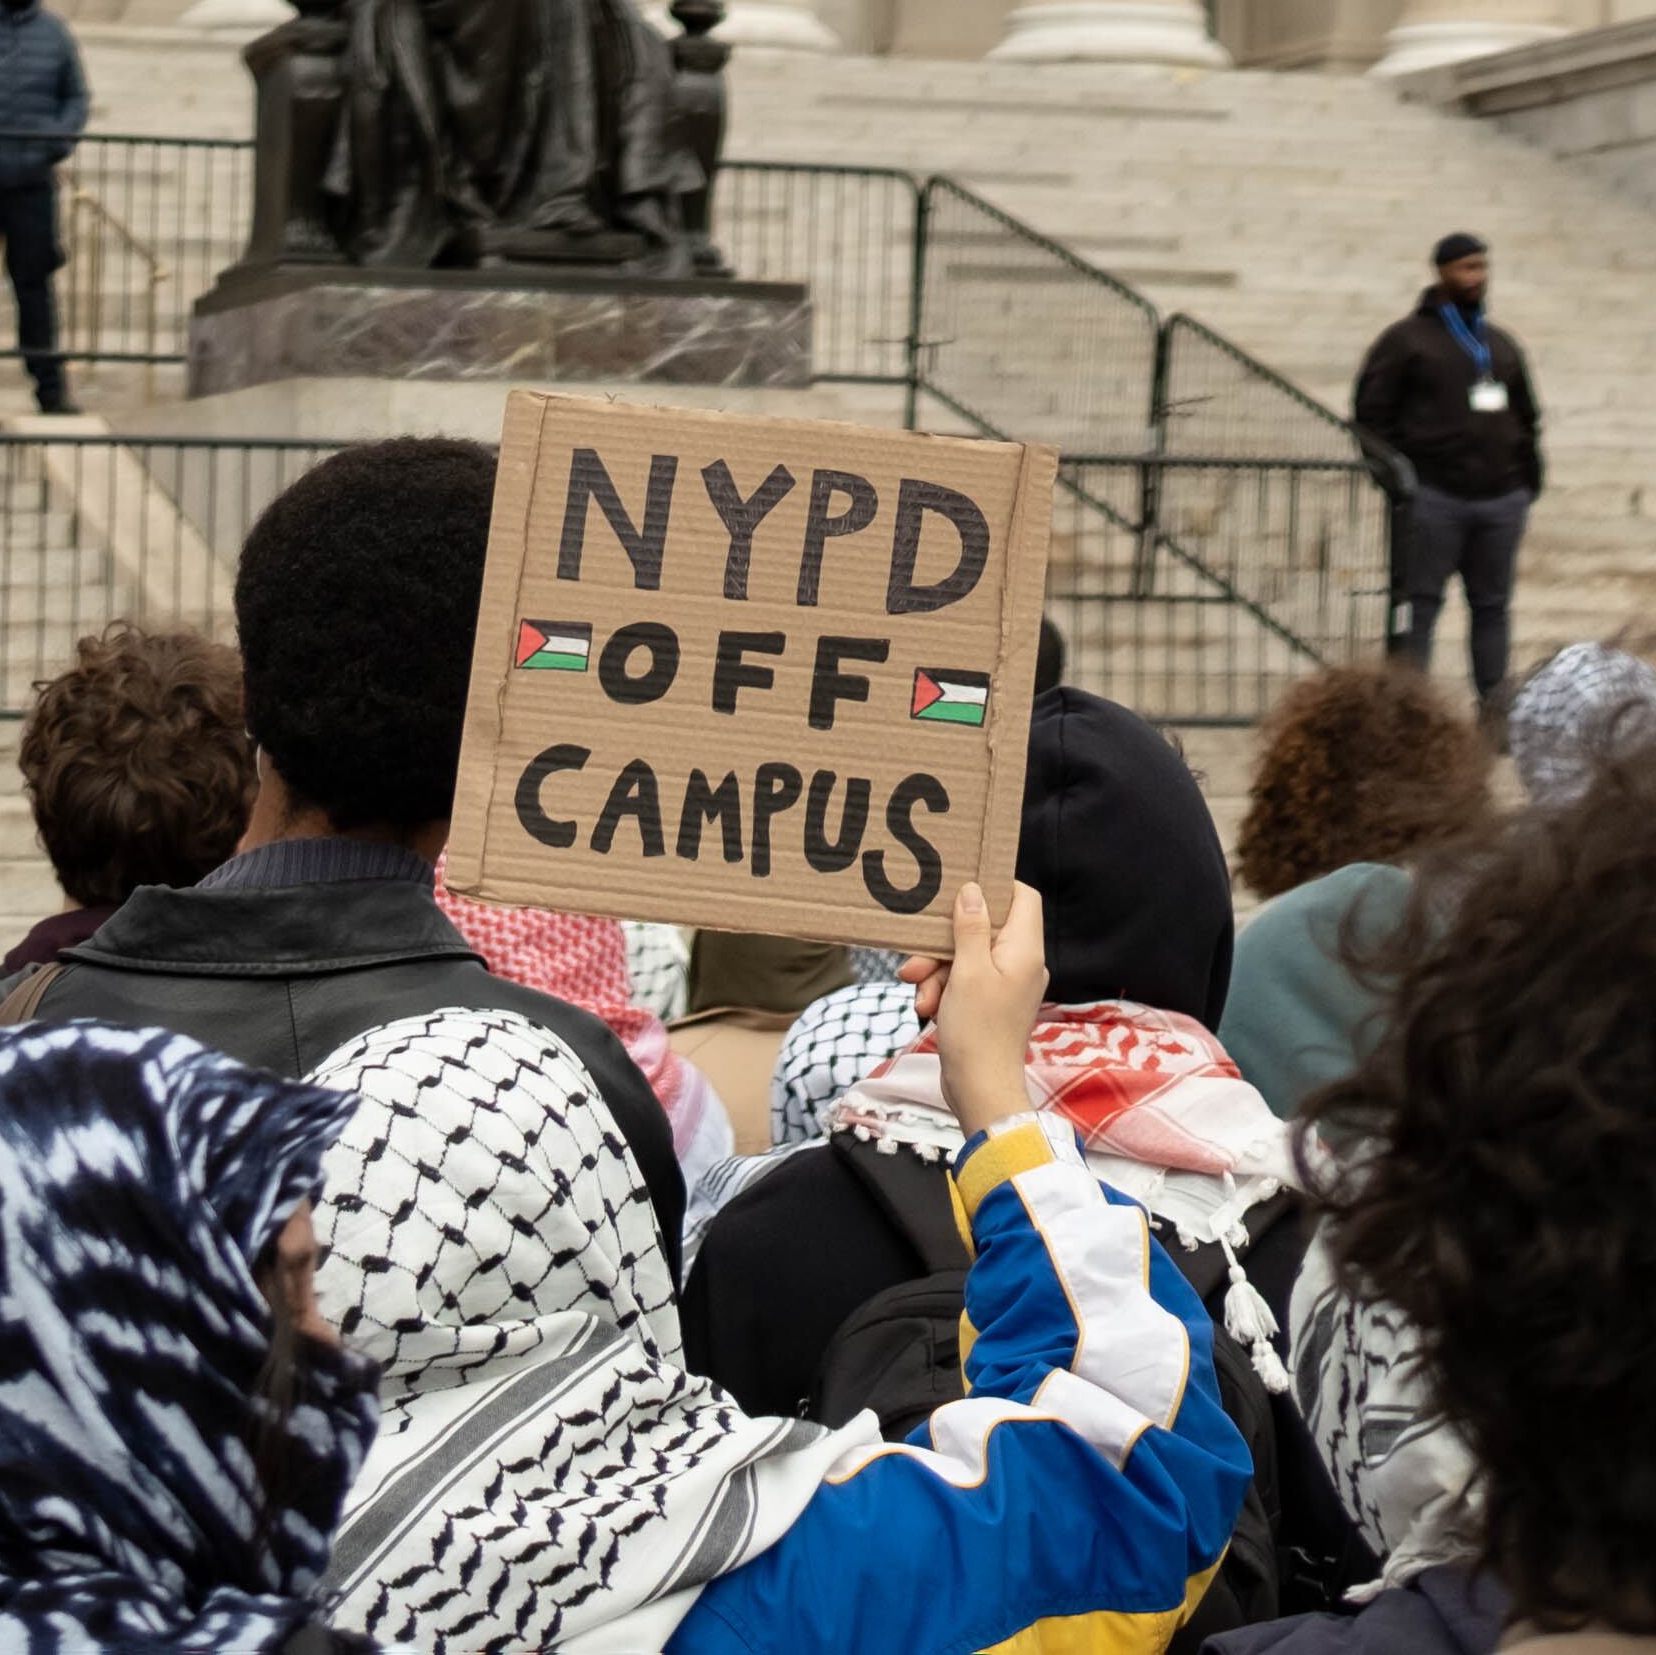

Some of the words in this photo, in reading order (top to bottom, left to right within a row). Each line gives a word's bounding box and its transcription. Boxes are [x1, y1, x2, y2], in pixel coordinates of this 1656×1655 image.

[556, 448, 991, 615] NYPD
[598, 621, 891, 731] OFF
[514, 744, 950, 915] CAMPUS
